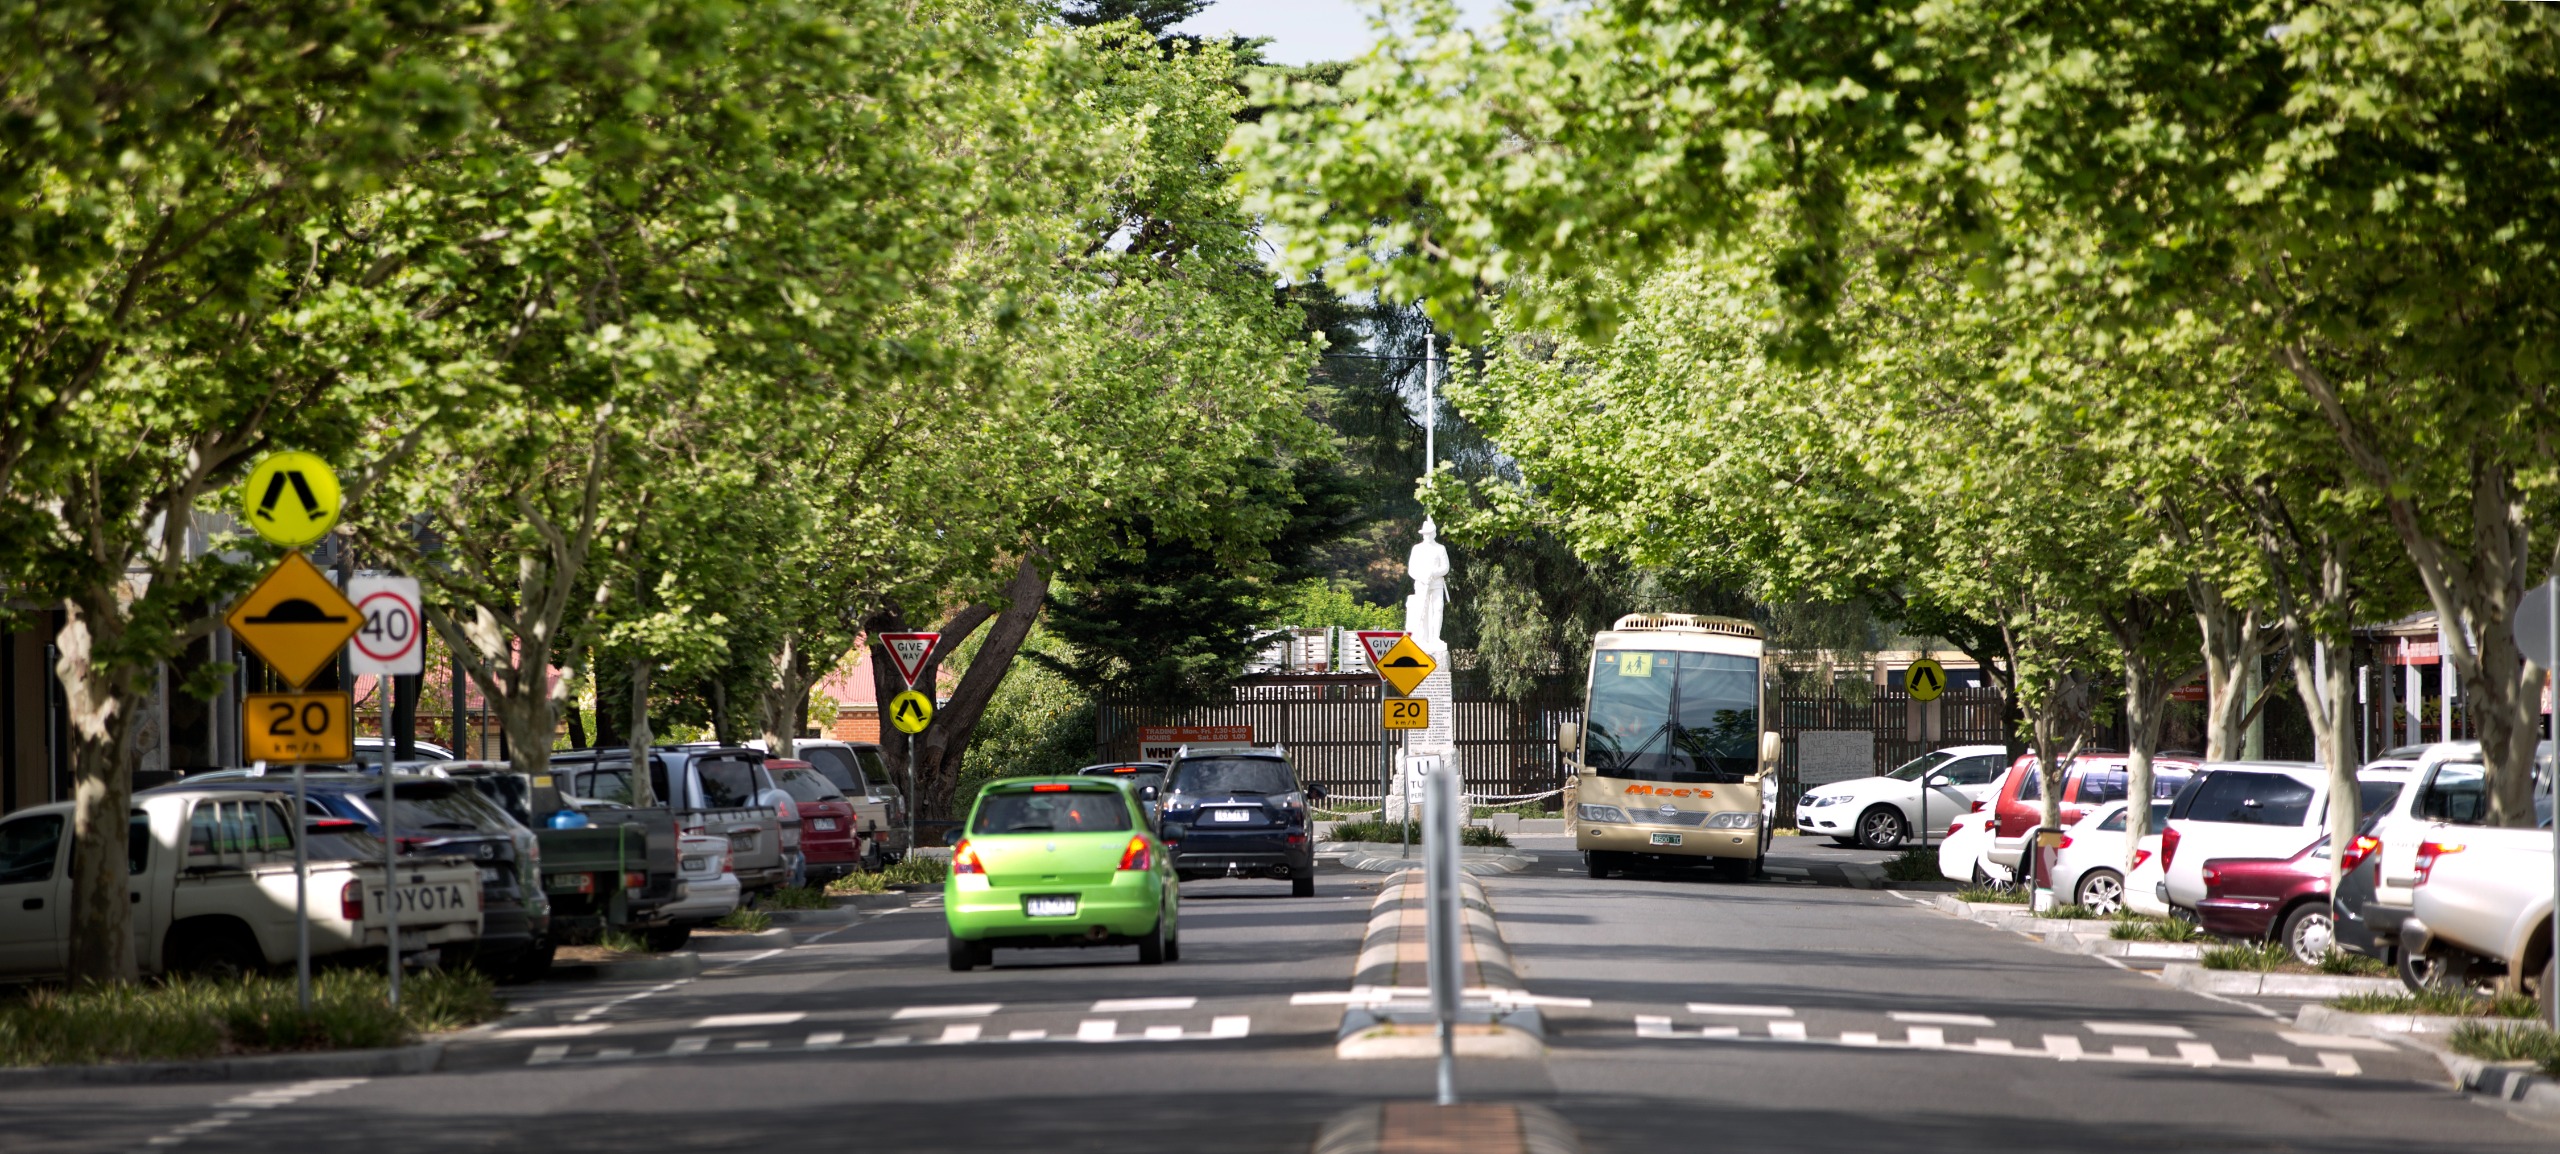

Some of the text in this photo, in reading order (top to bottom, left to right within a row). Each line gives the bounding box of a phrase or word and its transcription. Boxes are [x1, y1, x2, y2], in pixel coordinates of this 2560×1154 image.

[361, 608, 408, 642] 40
[897, 643, 923, 651] GIVE
[1372, 640, 1396, 648] GIVE
[1393, 702, 1420, 718] 20
[268, 701, 330, 736] 20
[274, 742, 321, 753] km/h
[1417, 760, 1429, 776] U
[1625, 784, 1714, 799] Mee's
